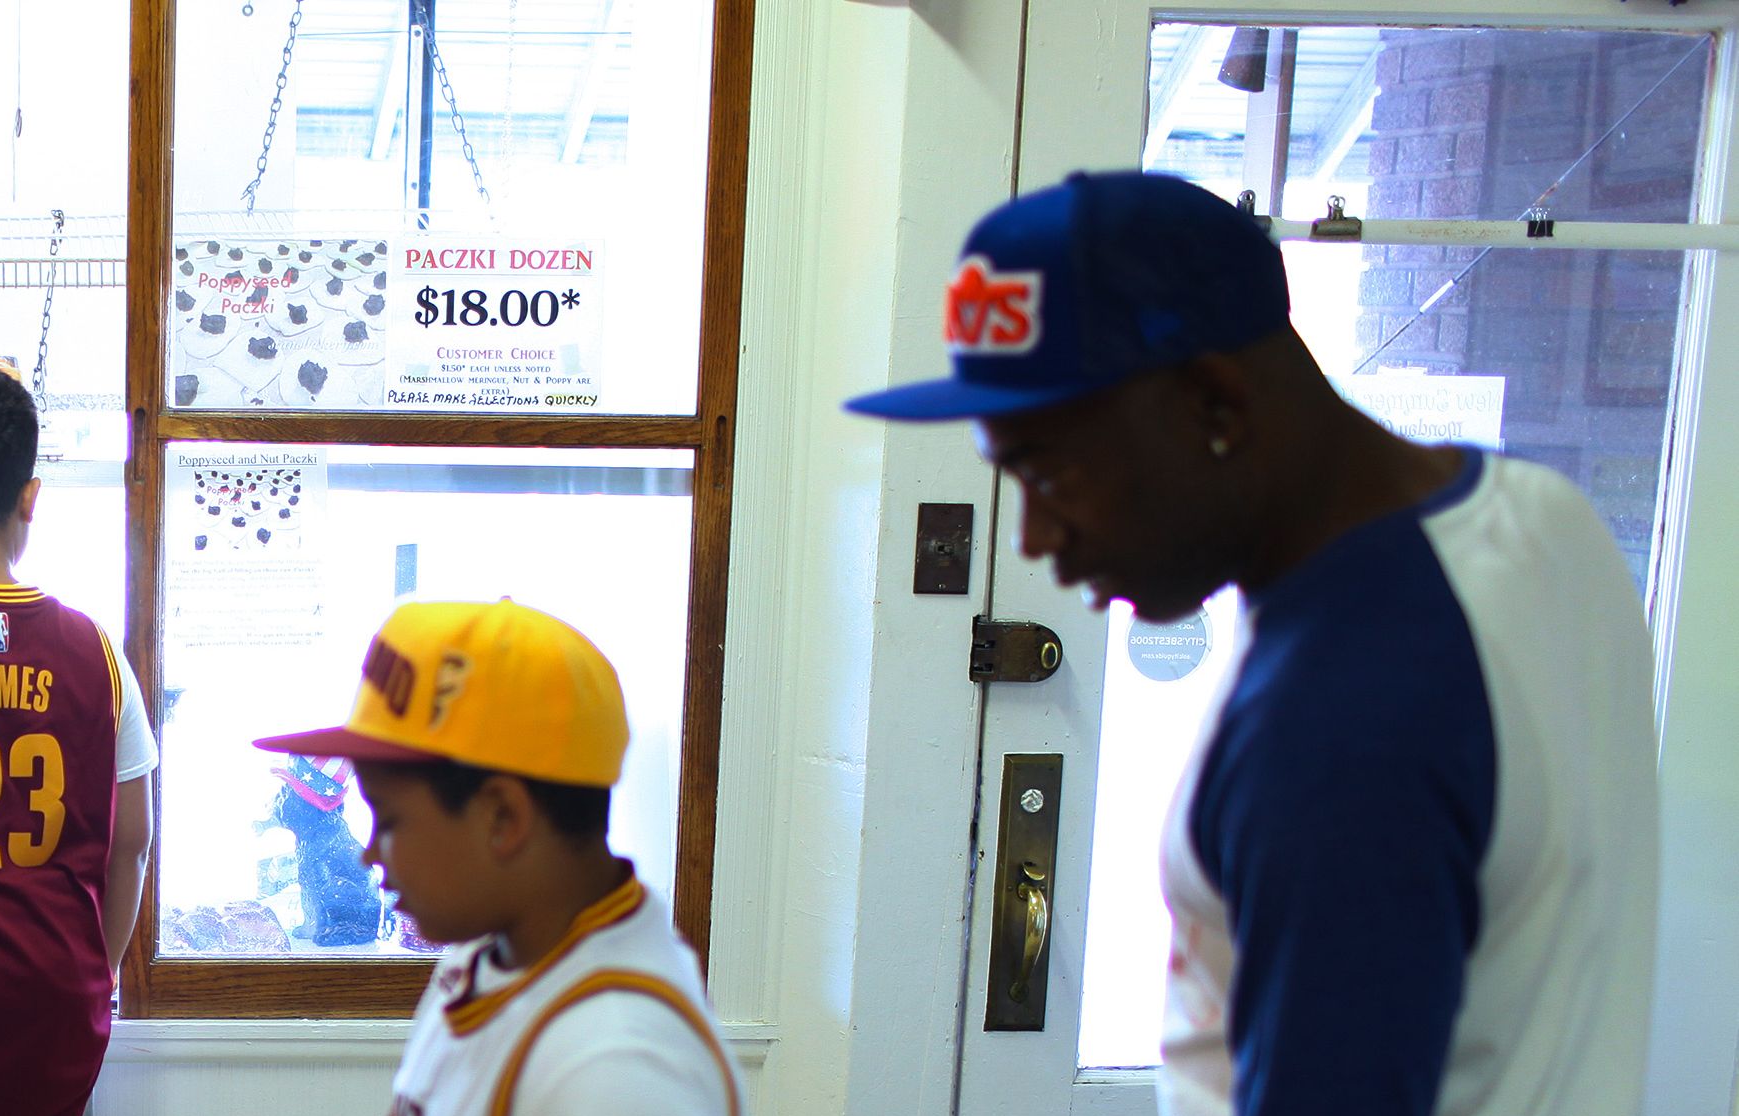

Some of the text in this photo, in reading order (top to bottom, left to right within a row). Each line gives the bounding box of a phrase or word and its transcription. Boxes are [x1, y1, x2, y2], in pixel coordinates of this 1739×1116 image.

[405, 248, 593, 271] PACZKI DOZEN
[198, 270, 291, 292] Poppyseed
[222, 297, 275, 314] Paczki
[437, 347, 556, 360] CUSTOMER CHOICE
[470, 365, 490, 373] EACH
[494, 365, 521, 373] UNLESS
[525, 365, 551, 373] NOTED
[399, 375, 465, 385] (MARSHMALLOW
[513, 375, 529, 385] NUT
[534, 376, 541, 384] &
[545, 376, 572, 385] POPPY
[576, 376, 592, 385] ARE
[388, 390, 598, 407] PLEASE MAKE SELECTIONS QUICKLY
[178, 453, 318, 467] Poppyseed and Nut Paczki
